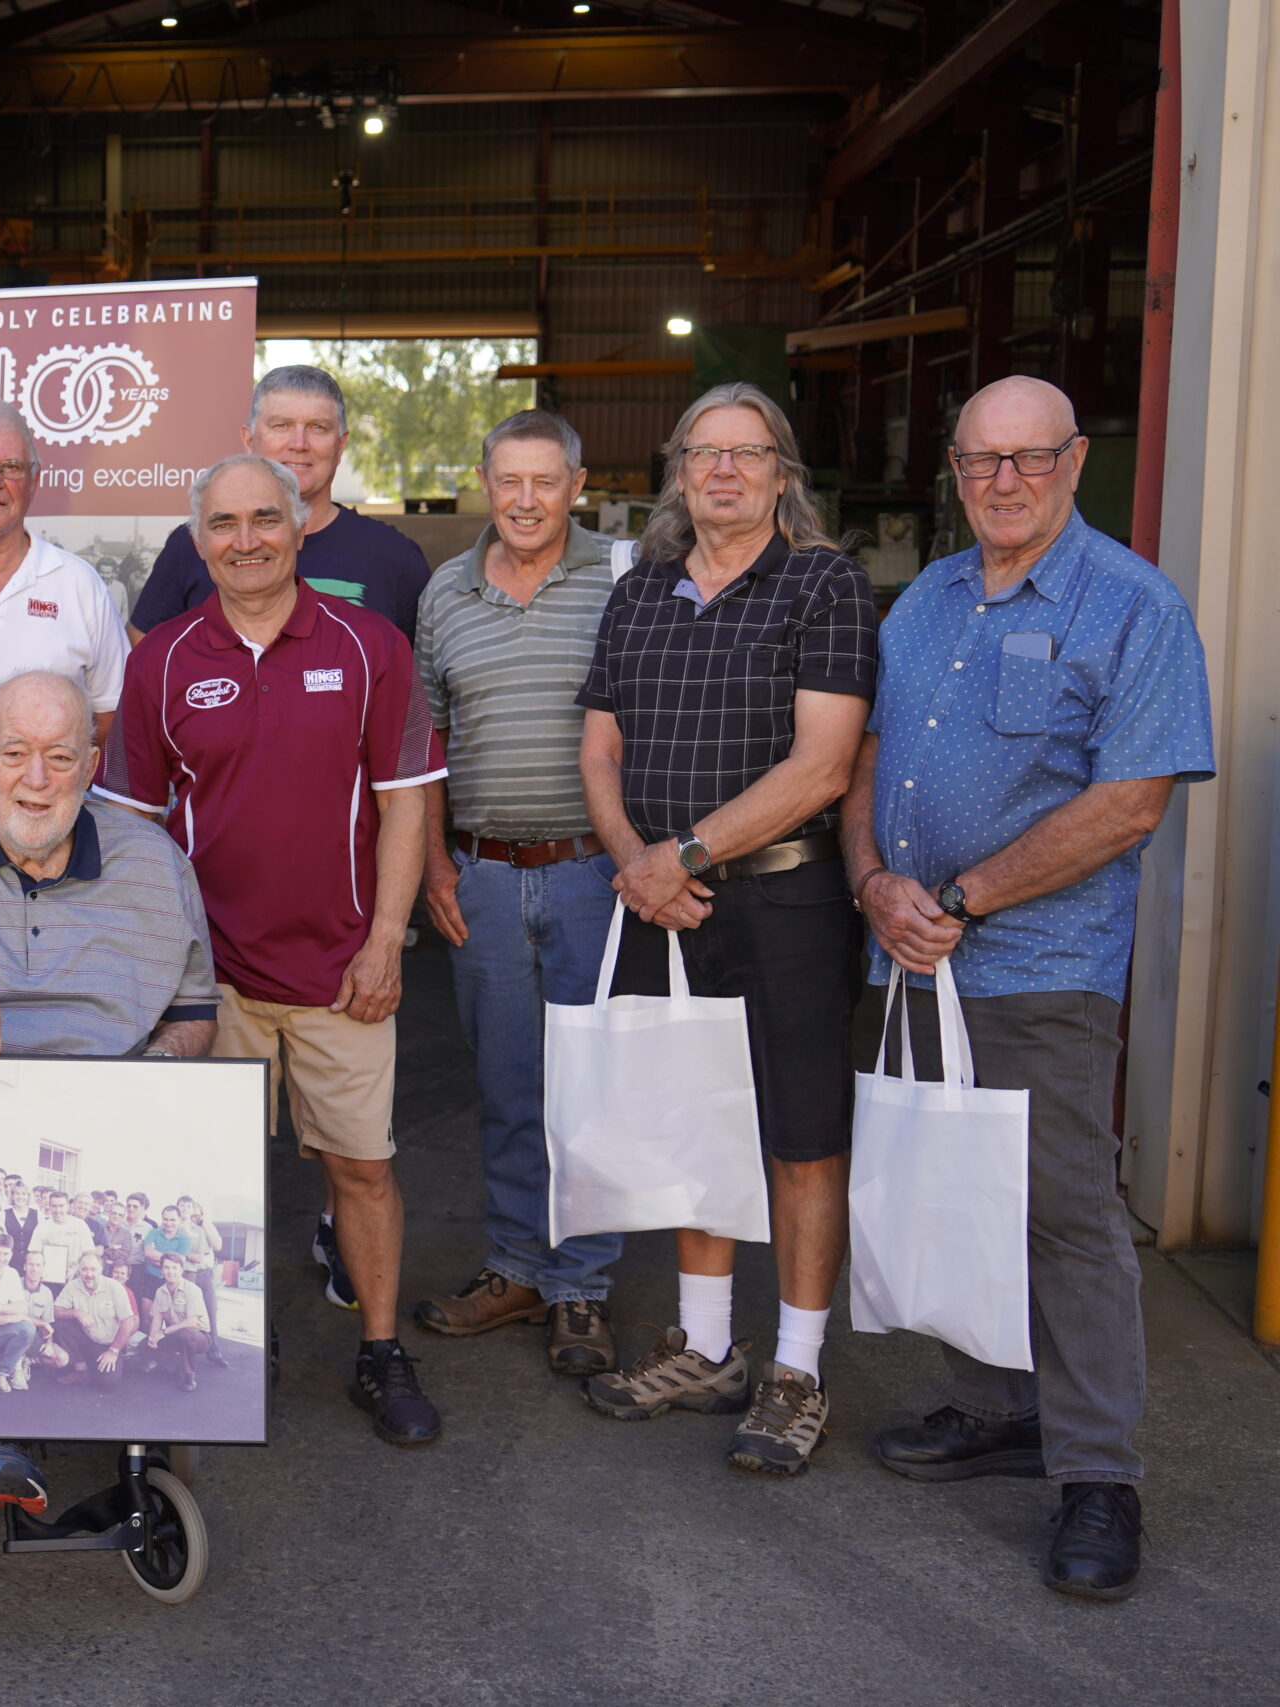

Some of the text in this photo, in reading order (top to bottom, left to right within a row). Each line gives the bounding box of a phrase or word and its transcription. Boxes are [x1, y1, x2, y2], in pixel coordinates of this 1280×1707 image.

[51, 301, 233, 327] CELEBRATING
[120, 388, 169, 400] YEARS
[94, 463, 207, 487] excellen
[29, 599, 58, 613] KINGS
[306, 671, 341, 684] KINGS
